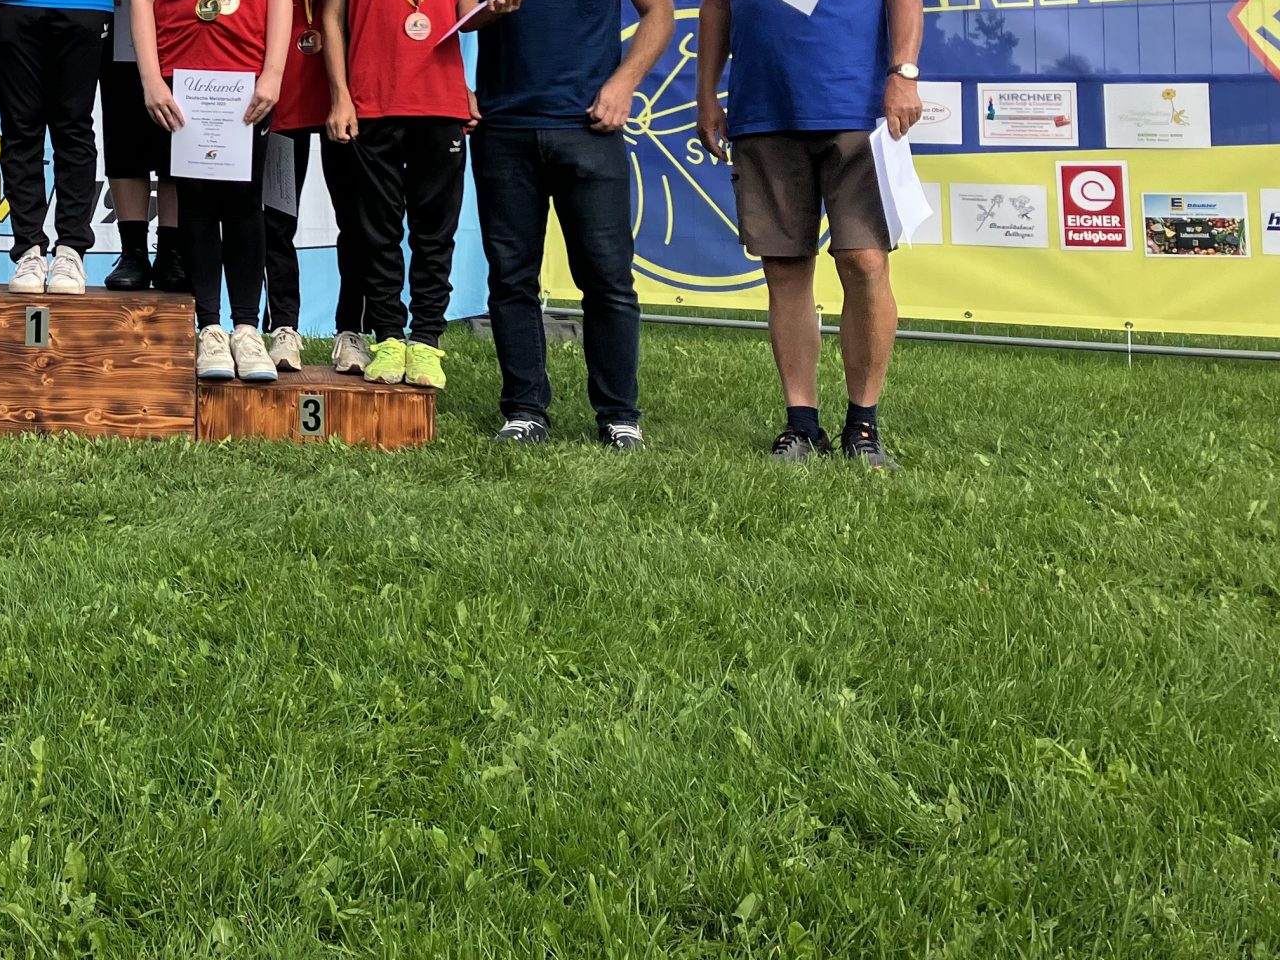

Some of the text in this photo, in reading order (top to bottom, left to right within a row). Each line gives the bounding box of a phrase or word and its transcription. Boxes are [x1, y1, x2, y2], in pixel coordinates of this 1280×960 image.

[184, 76, 245, 93] Urkunde
[999, 93, 1062, 102] KIRCHNER
[1067, 215, 1122, 227] EIGNER
[1068, 230, 1122, 244] fertigbau
[30, 311, 42, 343] 1
[302, 399, 321, 432] 3
